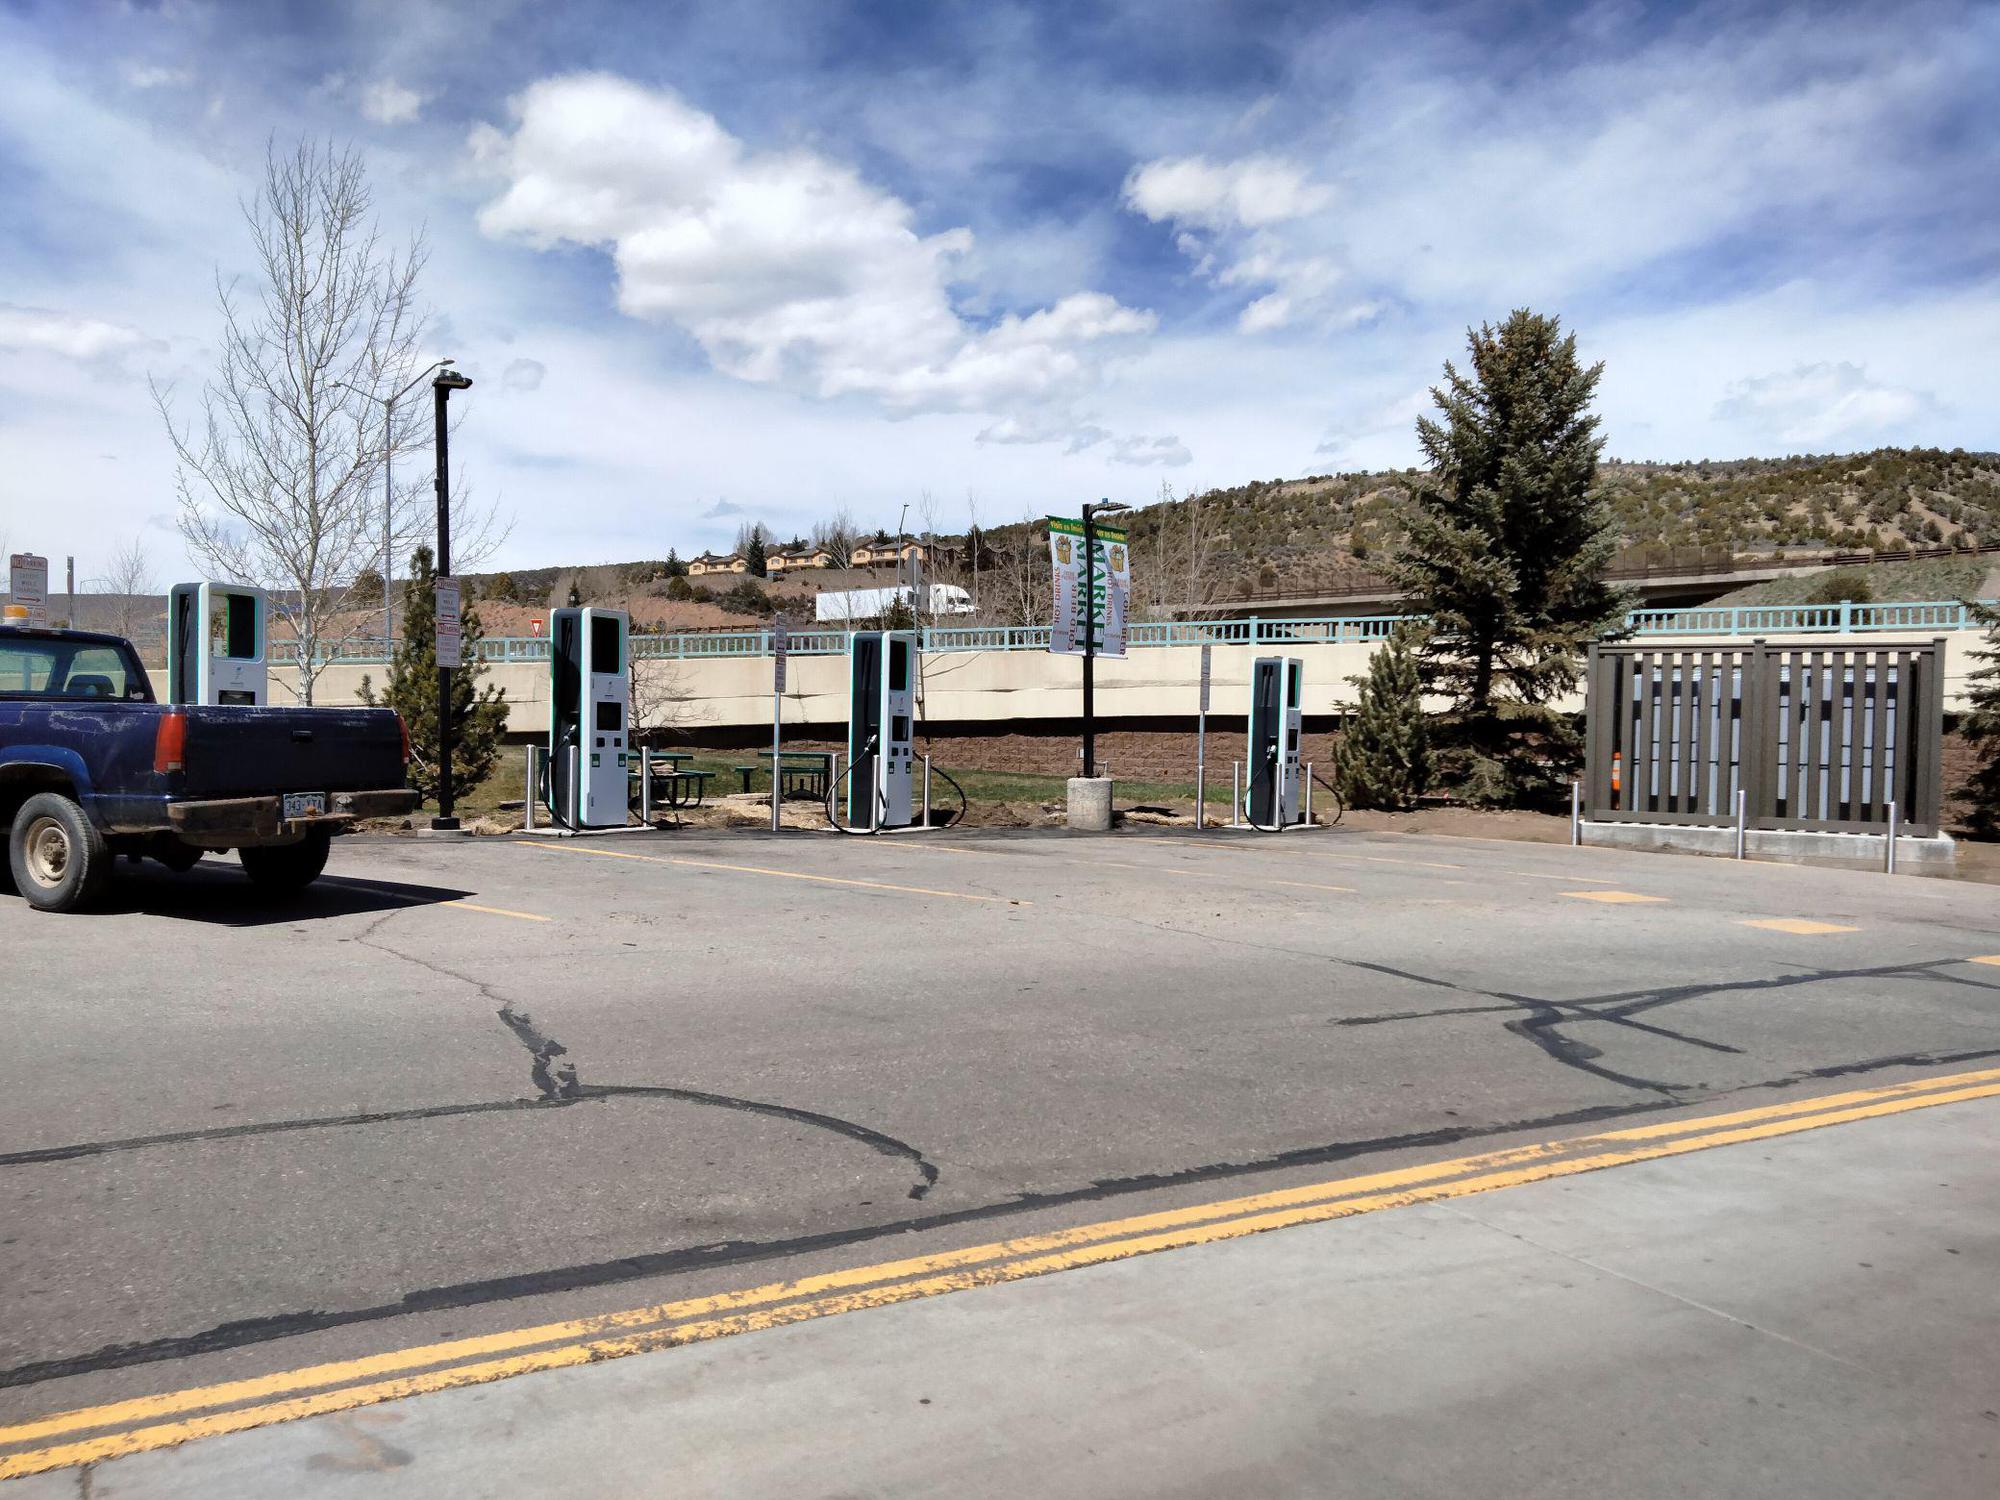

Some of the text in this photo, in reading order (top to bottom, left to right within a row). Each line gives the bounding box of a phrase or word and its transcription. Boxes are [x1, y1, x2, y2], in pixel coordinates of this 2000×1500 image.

[1093, 543, 1106, 653] MARKET
[1068, 618, 1077, 651] COLD
[1119, 627, 1128, 656] BEER
